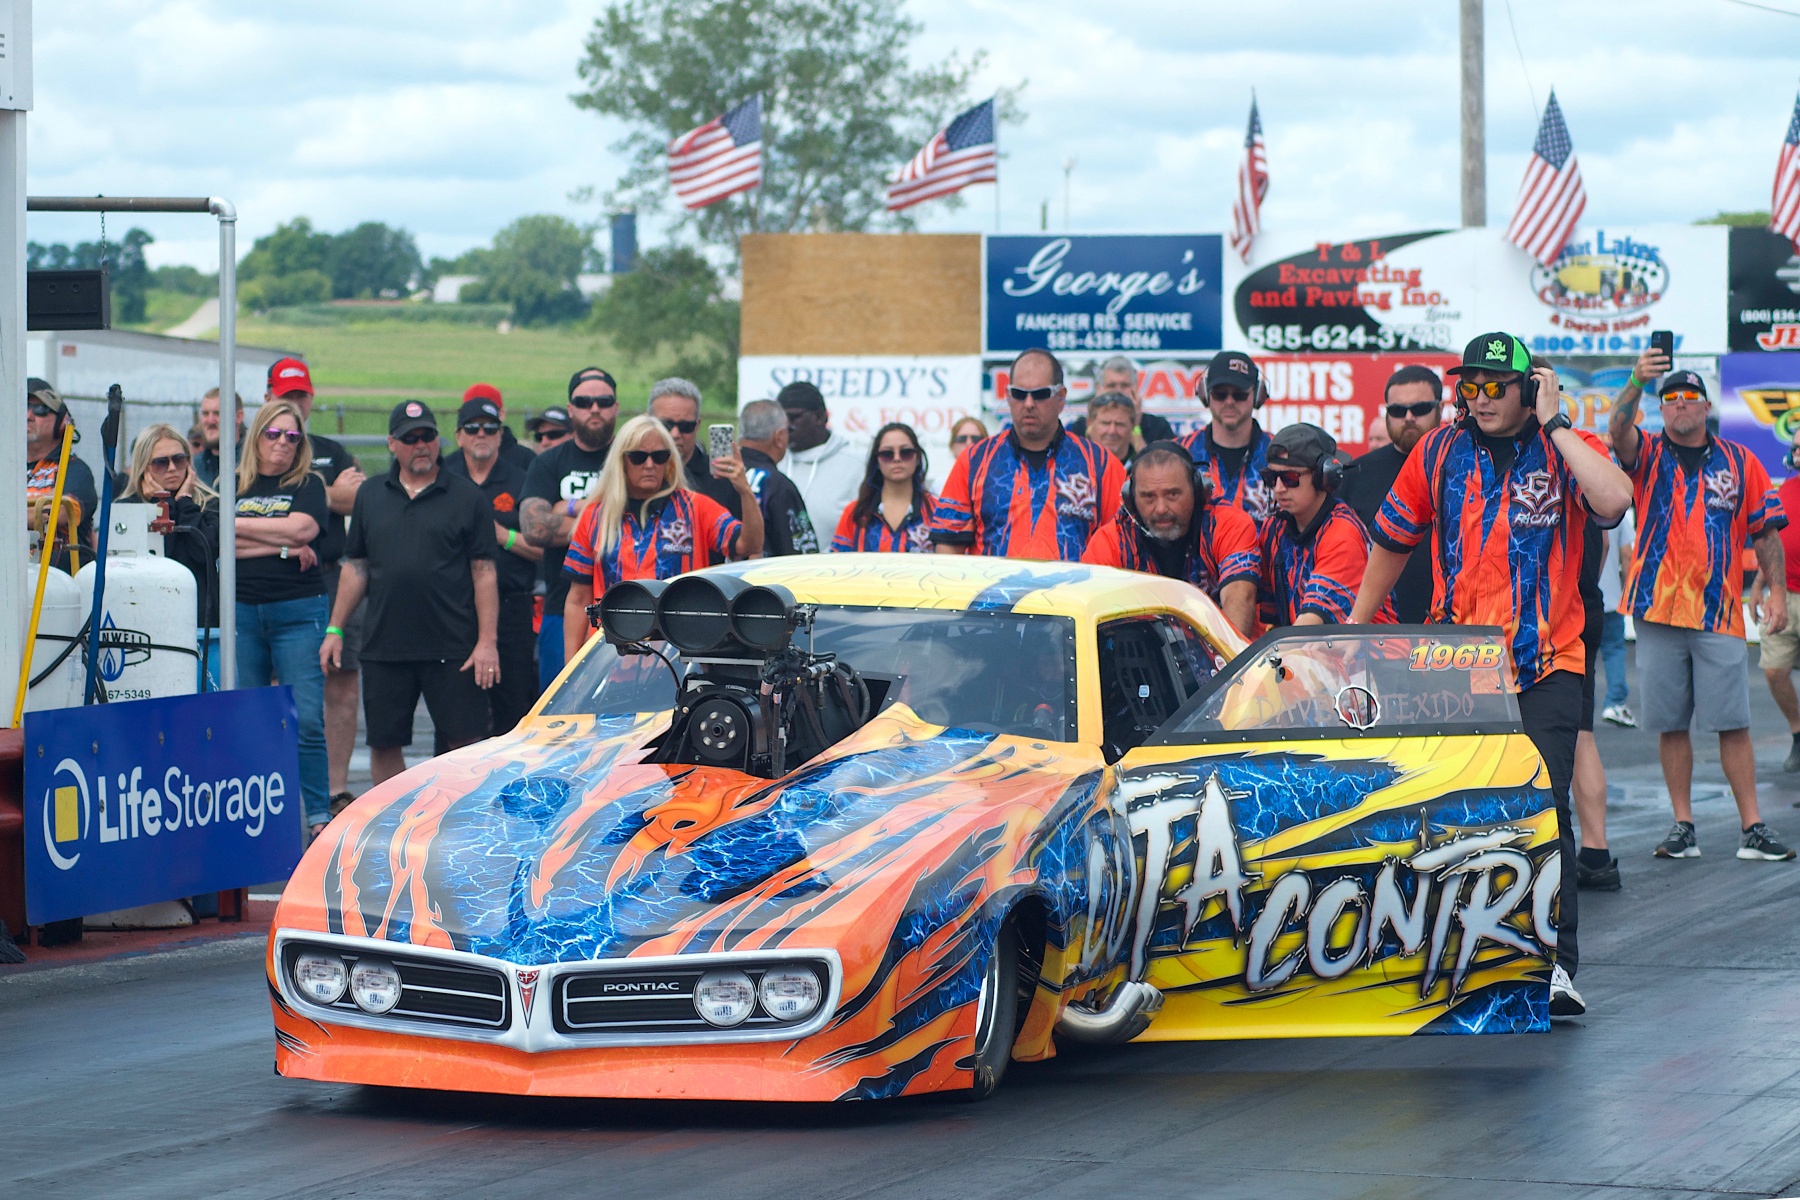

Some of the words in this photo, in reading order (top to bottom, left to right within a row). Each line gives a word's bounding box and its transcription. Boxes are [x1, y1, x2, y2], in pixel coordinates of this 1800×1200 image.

[1315, 241, 1332, 262] T
[1341, 242, 1362, 262] &
[1370, 241, 1386, 260] L
[1597, 230, 1660, 262] Lakes
[1003, 238, 1206, 315] George's
[1278, 264, 1421, 288] Excavating
[1250, 287, 1297, 307] and
[1305, 286, 1392, 311] Paving
[1401, 286, 1449, 306] Inc.
[1016, 312, 1090, 331] FANCHER
[1093, 312, 1121, 331] RD.
[1124, 312, 1193, 331] SERVICE
[1741, 308, 1771, 324] (800)
[768, 367, 948, 398] SPEEDY'S
[1512, 511, 1561, 527] RACING
[1408, 643, 1506, 671] 196B
[106, 689, 151, 700] 67-5349
[603, 981, 680, 993] PONTIAC
